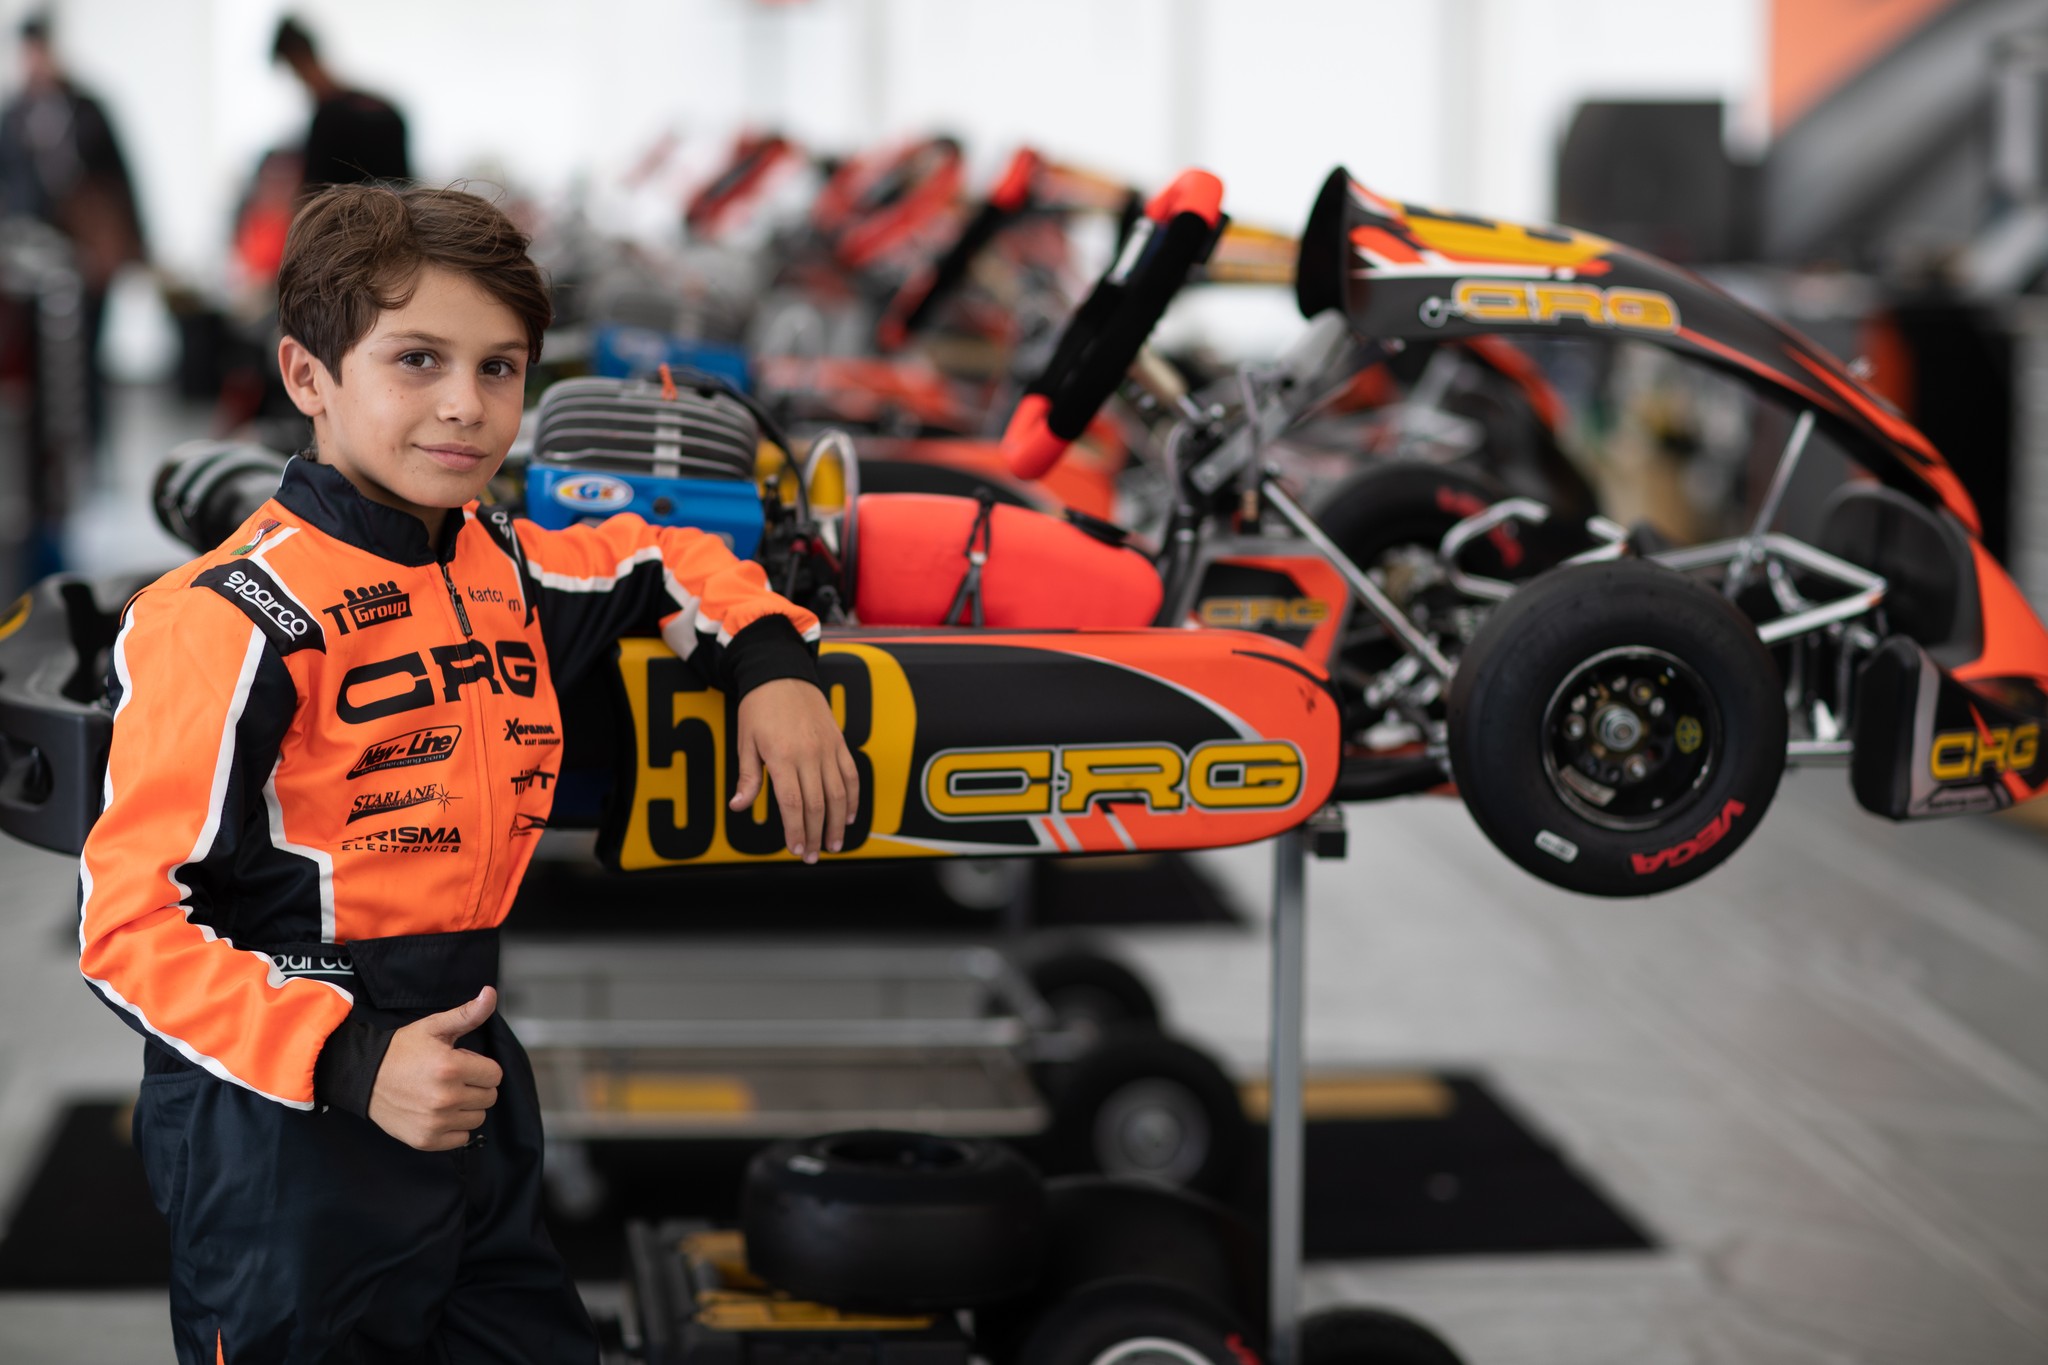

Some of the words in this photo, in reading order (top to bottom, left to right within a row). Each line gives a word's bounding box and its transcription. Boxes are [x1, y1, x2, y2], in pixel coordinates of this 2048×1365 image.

[224, 570, 308, 636] sparco
[322, 603, 350, 635] T
[354, 600, 408, 624] Group
[468, 586, 521, 612] kartcm
[336, 638, 537, 725] CRG
[1928, 722, 2041, 782] CRG
[351, 784, 437, 813] STARLANE
[921, 740, 1307, 822] CRG
[342, 827, 462, 844] RISMA
[342, 843, 461, 854] ELECTRONICS
[1630, 798, 1746, 876] VEGA
